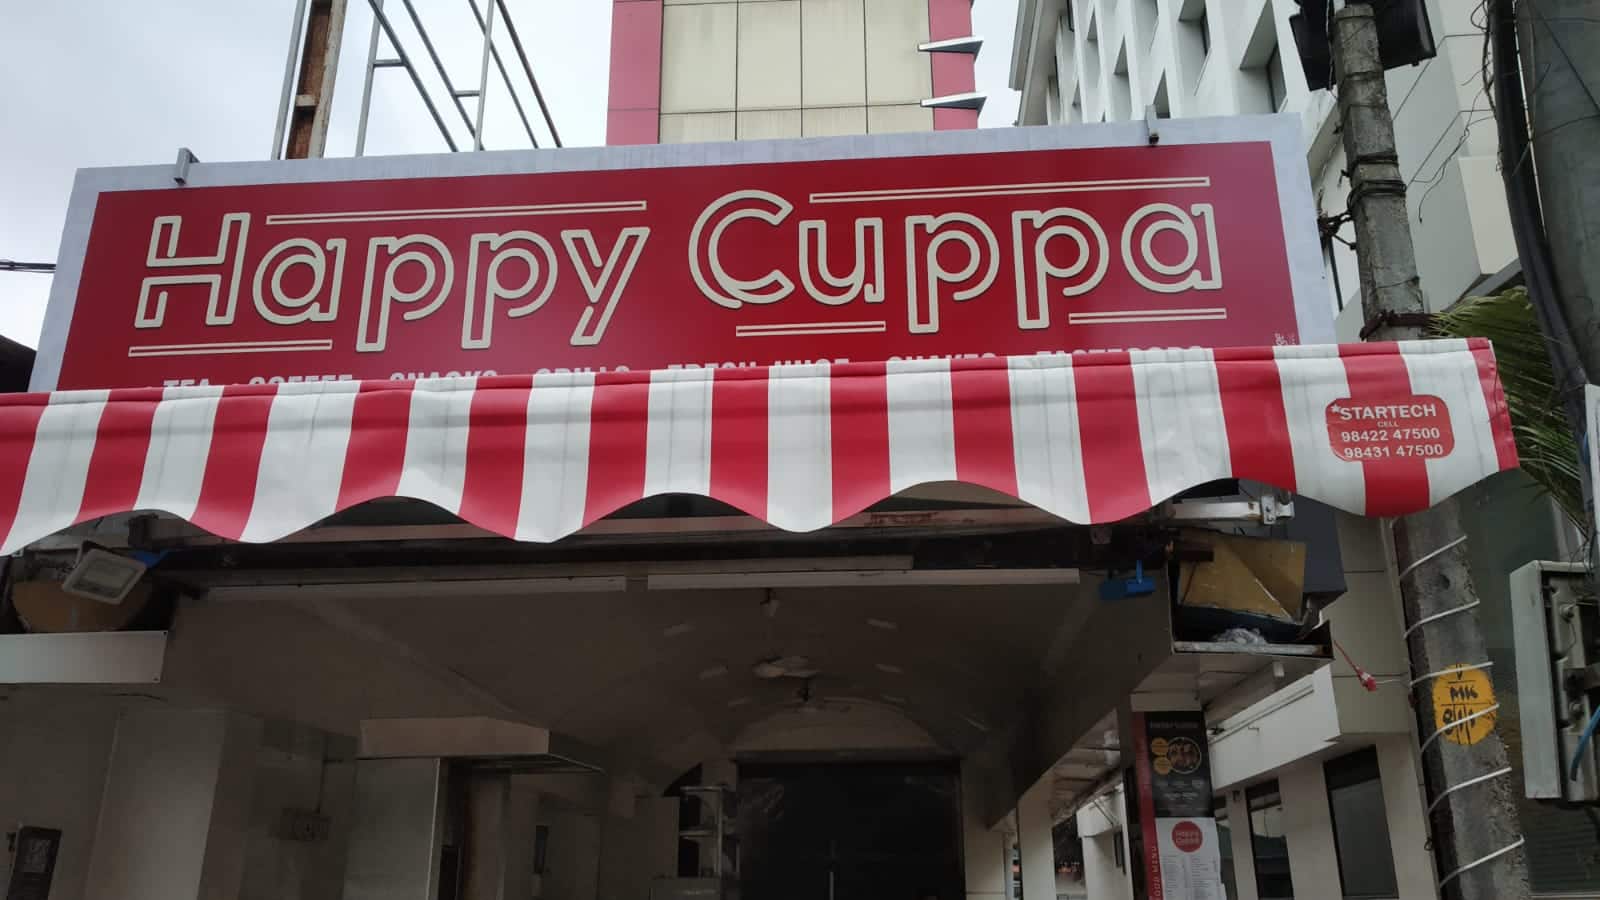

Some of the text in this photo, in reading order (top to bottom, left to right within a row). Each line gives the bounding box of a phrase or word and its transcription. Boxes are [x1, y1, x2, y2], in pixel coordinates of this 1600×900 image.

[134, 189, 1223, 352] Happy Cuppa
[1340, 404, 1437, 420] STARTECH
[1341, 427, 1441, 442] 98422 47500
[1344, 444, 1444, 458] 98431 47500
